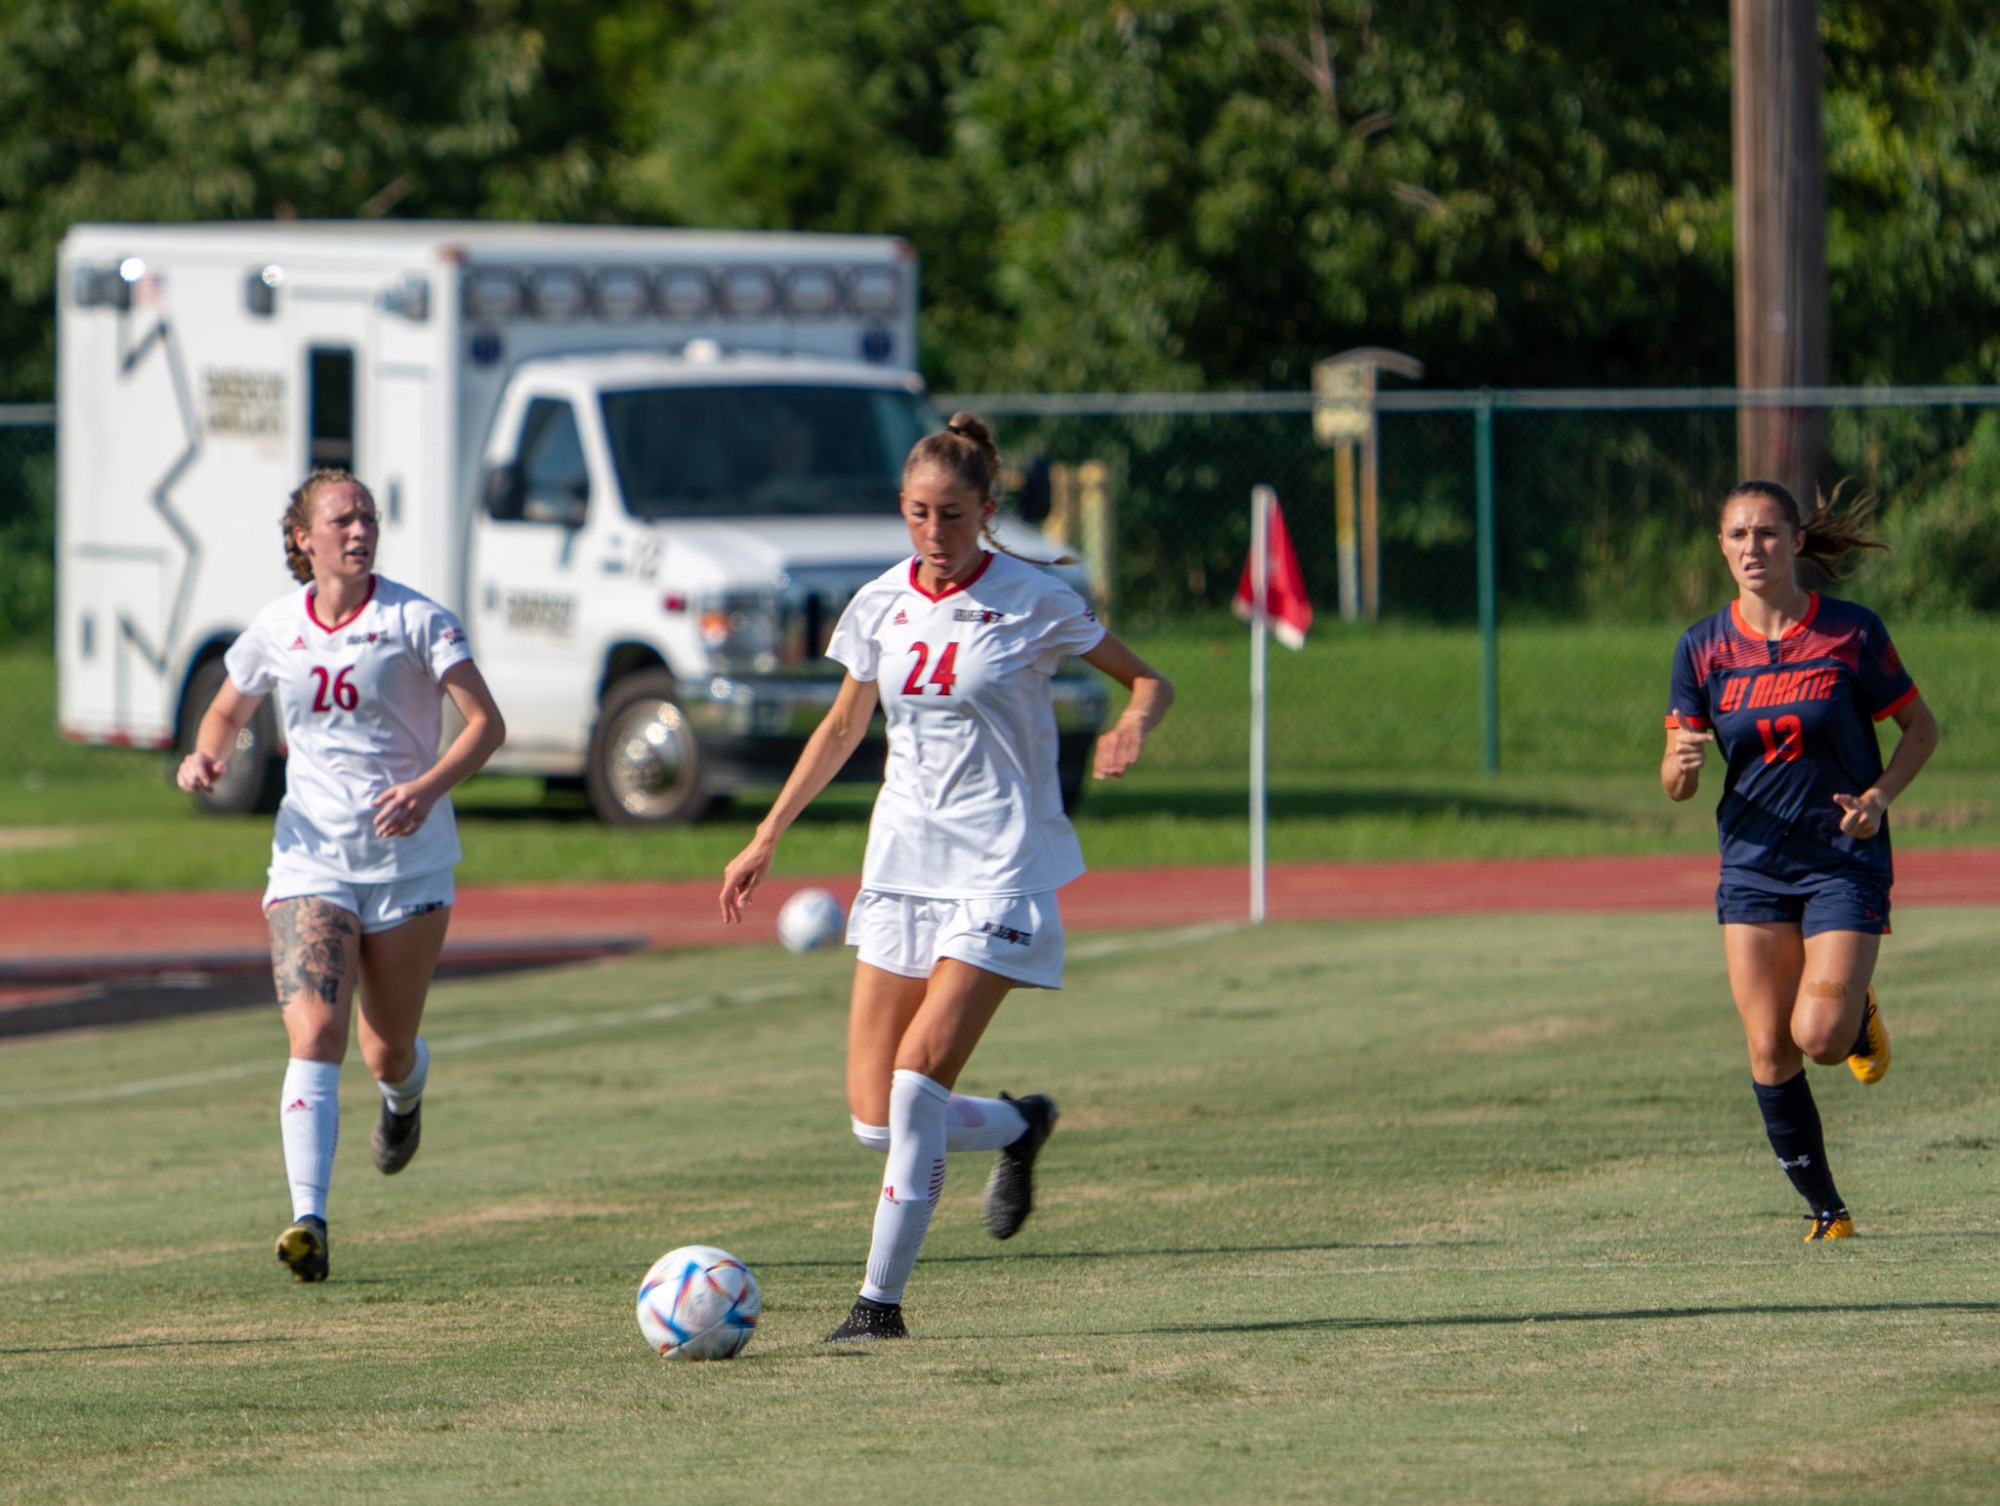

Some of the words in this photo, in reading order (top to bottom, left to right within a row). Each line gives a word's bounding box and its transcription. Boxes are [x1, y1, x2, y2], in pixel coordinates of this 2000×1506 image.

[310, 665, 358, 712] 26
[901, 640, 960, 696] 24
[1719, 676, 1751, 711] UT
[1747, 667, 1839, 709] MARTIN
[1756, 713, 1803, 764] 13
